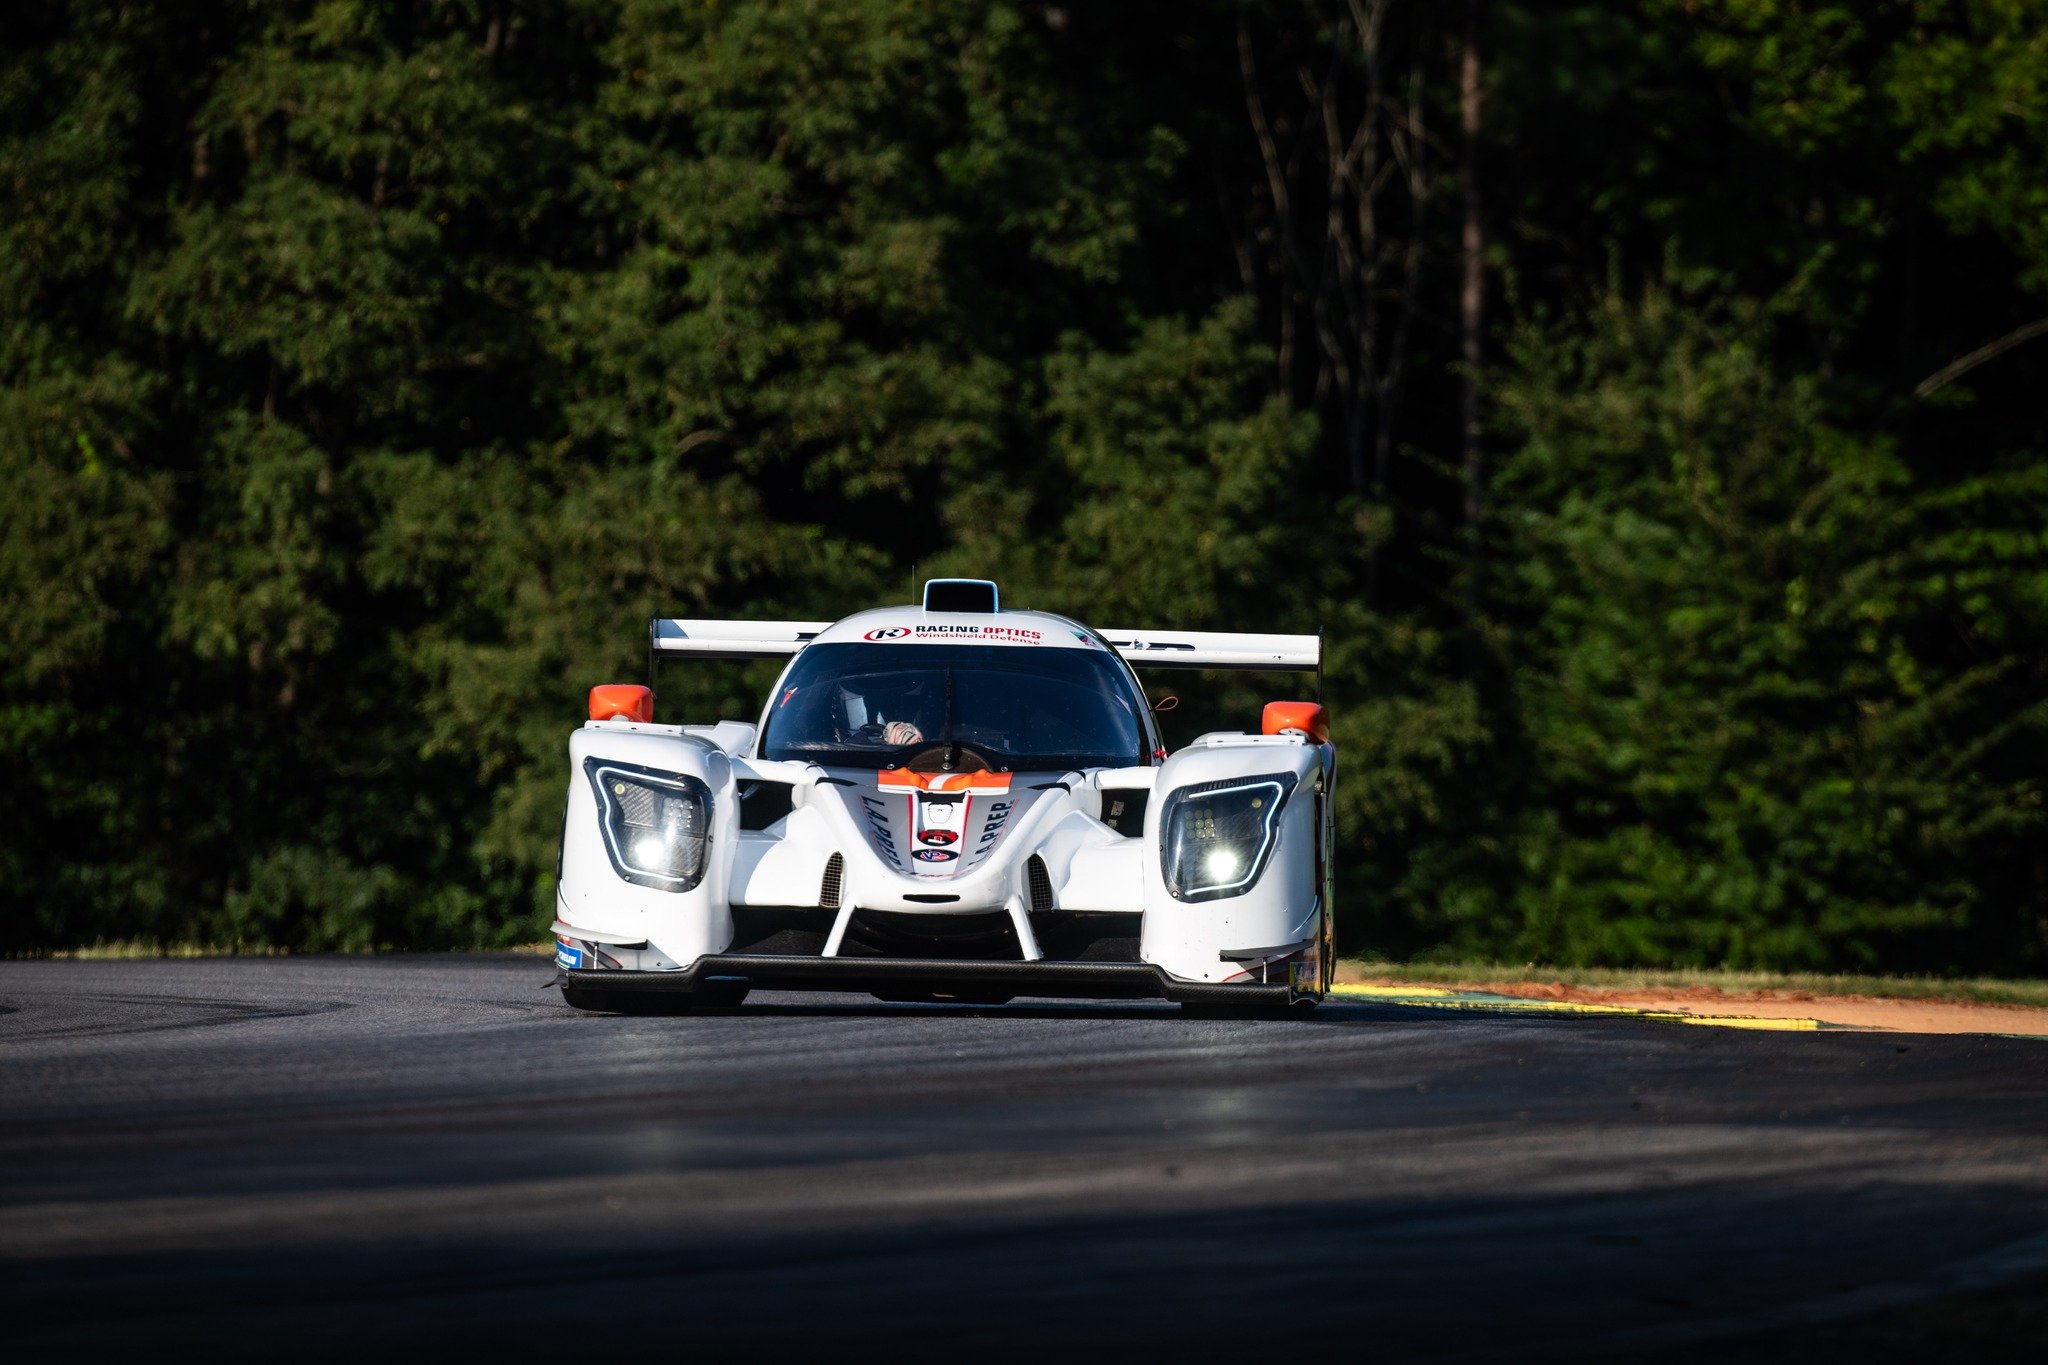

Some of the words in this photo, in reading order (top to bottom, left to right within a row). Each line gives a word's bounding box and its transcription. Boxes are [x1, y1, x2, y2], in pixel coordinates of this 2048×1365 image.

[915, 625, 979, 633] RACING
[983, 626, 1041, 639] OPTICS
[990, 634, 1040, 646] Defense
